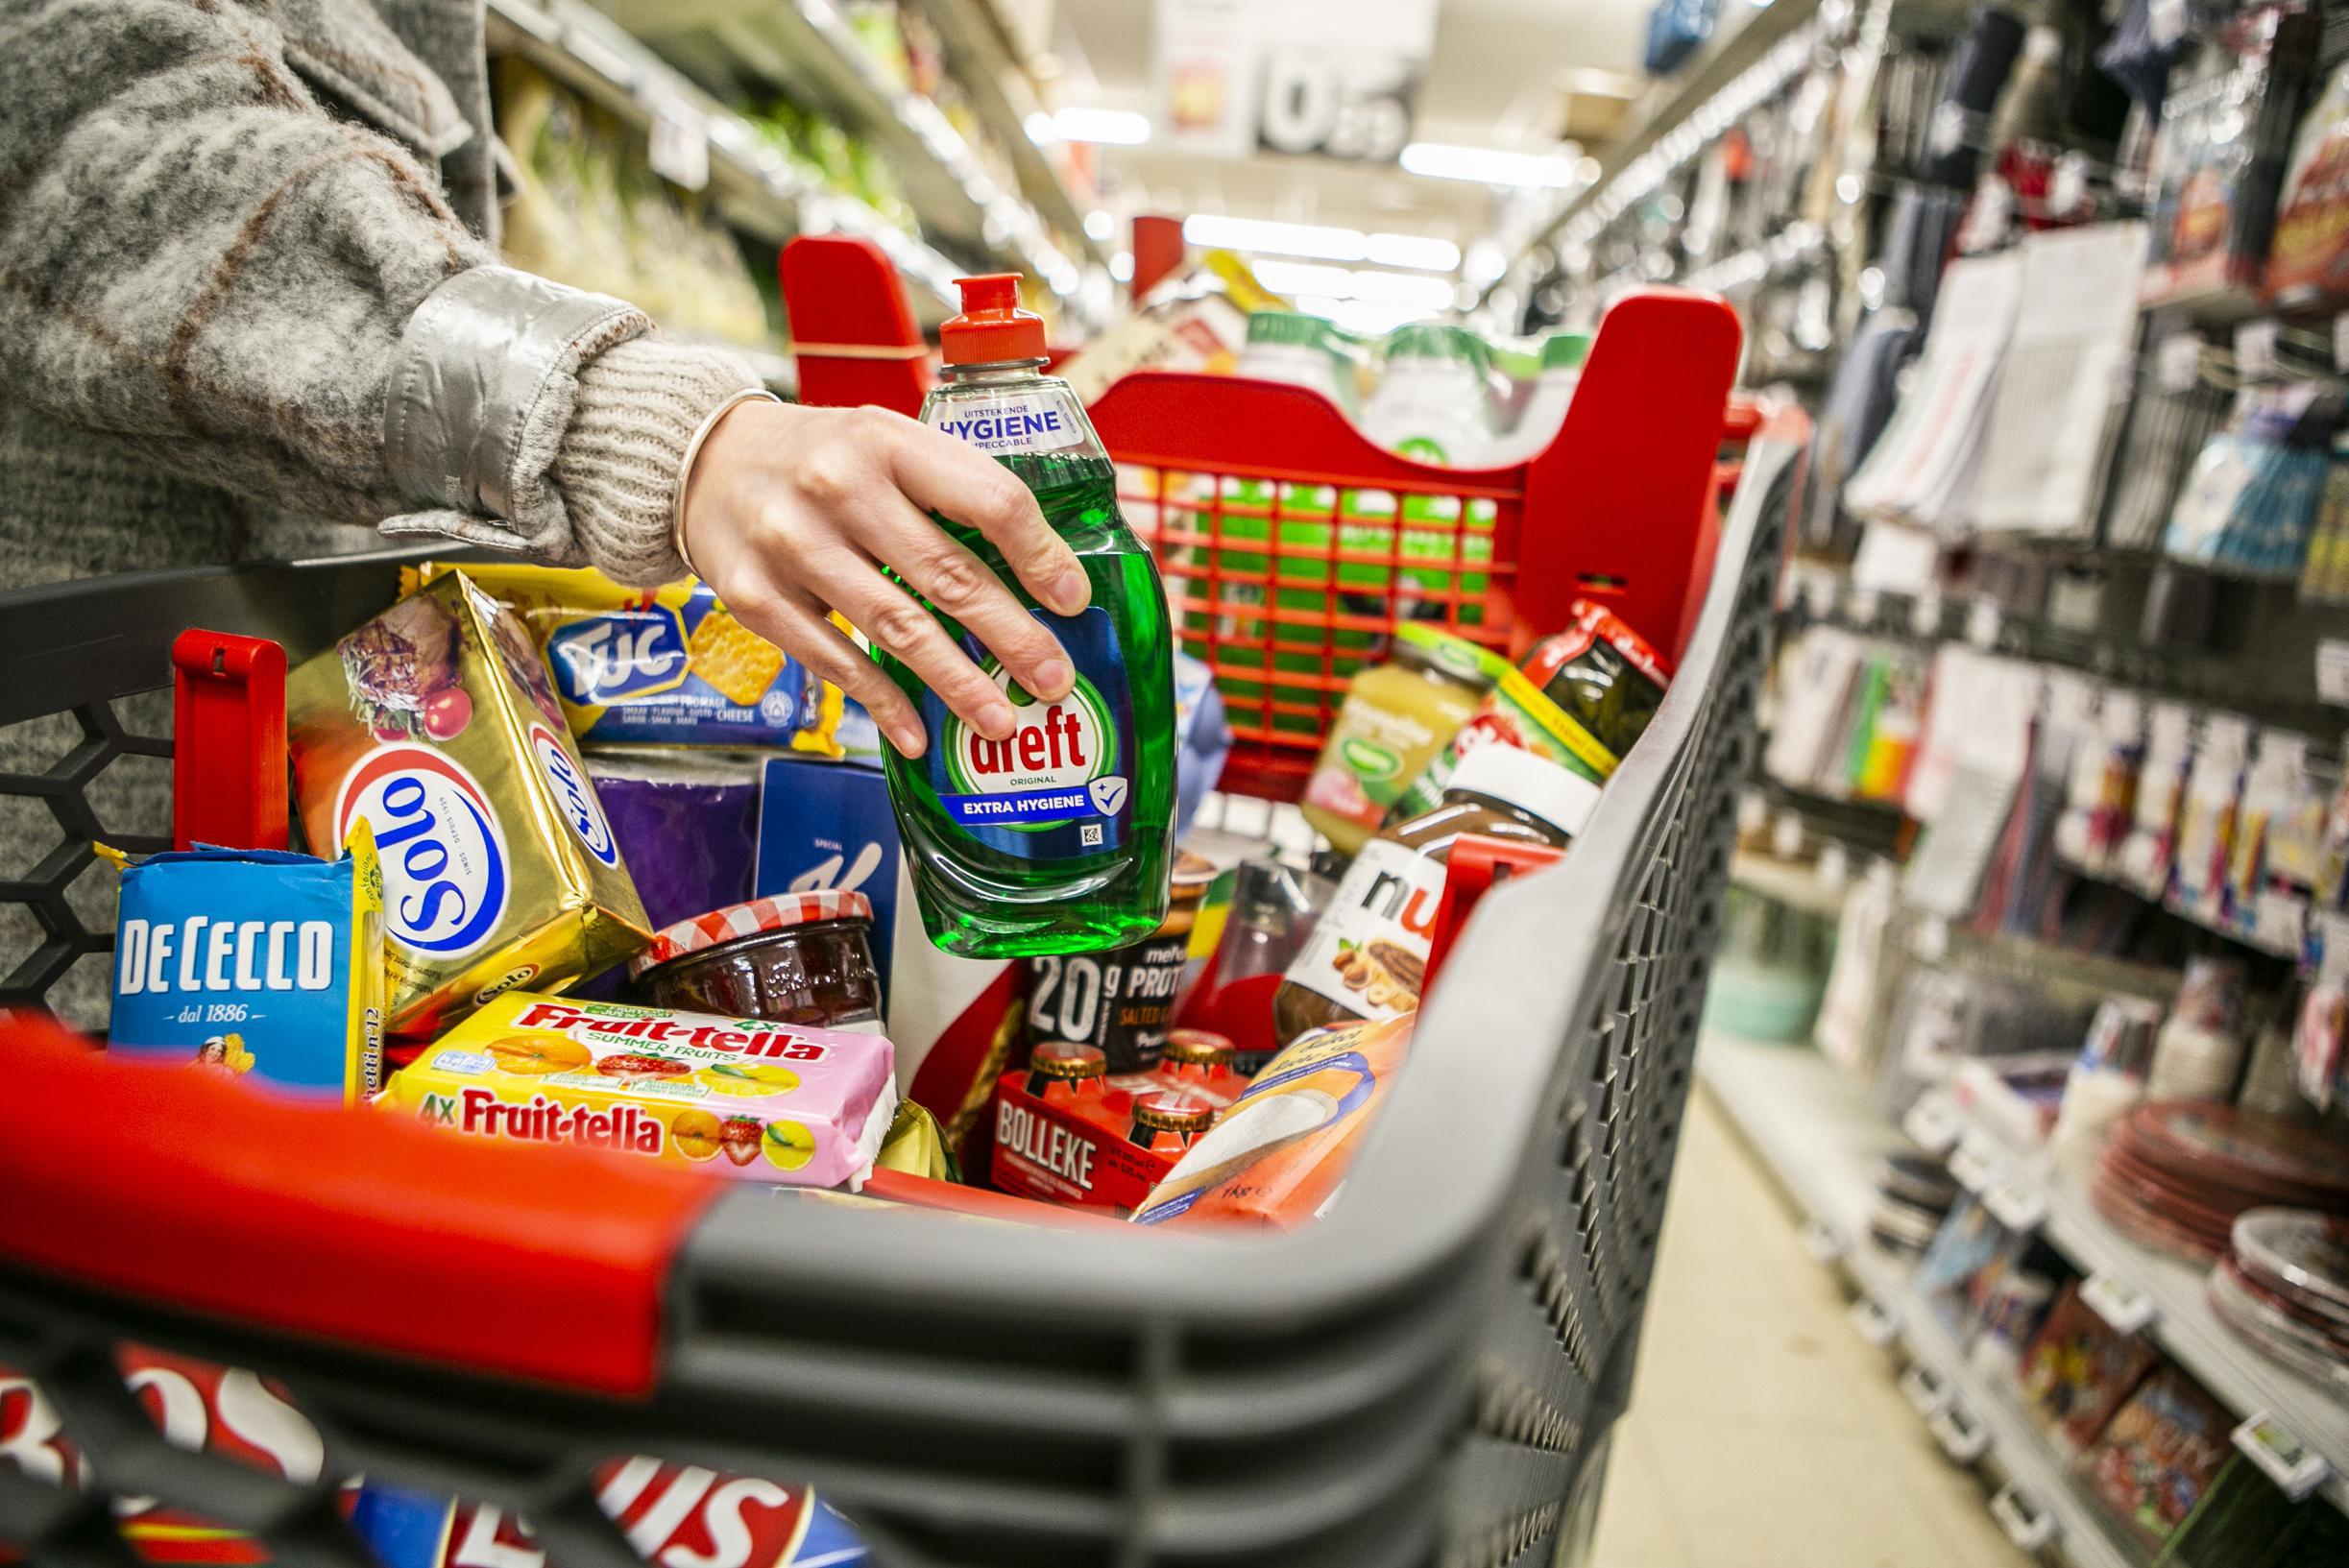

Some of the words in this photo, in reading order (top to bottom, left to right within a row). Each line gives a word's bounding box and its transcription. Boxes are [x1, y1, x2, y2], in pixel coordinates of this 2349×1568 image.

[940, 411, 1061, 441] HYGIENE
[964, 405, 1029, 419] UITSTEKENDE
[972, 437, 1032, 449] PECCABLE
[559, 621, 674, 695] TUC
[680, 695, 727, 708] FROMAGE
[716, 709, 754, 722] CHEESE
[970, 705, 1086, 775] dreft
[1009, 776, 1056, 786] ORIGINAL
[550, 748, 602, 850] Solo
[963, 801, 1014, 814] EXTRA
[1017, 795, 1085, 812] HYGIENE
[447, 816, 461, 844] DEPUIS
[814, 838, 843, 852] SPECIAL
[373, 776, 468, 932] Solo
[459, 852, 472, 876] SINDS
[118, 919, 175, 996] DE
[179, 915, 334, 993] CECCO
[481, 969, 532, 1001] Solo
[178, 1004, 204, 1025] dal
[206, 1002, 248, 1024] 1886
[520, 1004, 825, 1061] Fruit-tella
[586, 1032, 670, 1052] SUMMER
[674, 1044, 739, 1062] FRUITS
[462, 1090, 662, 1152] Fruit-tella
[997, 1098, 1097, 1191] BOLLEKE
